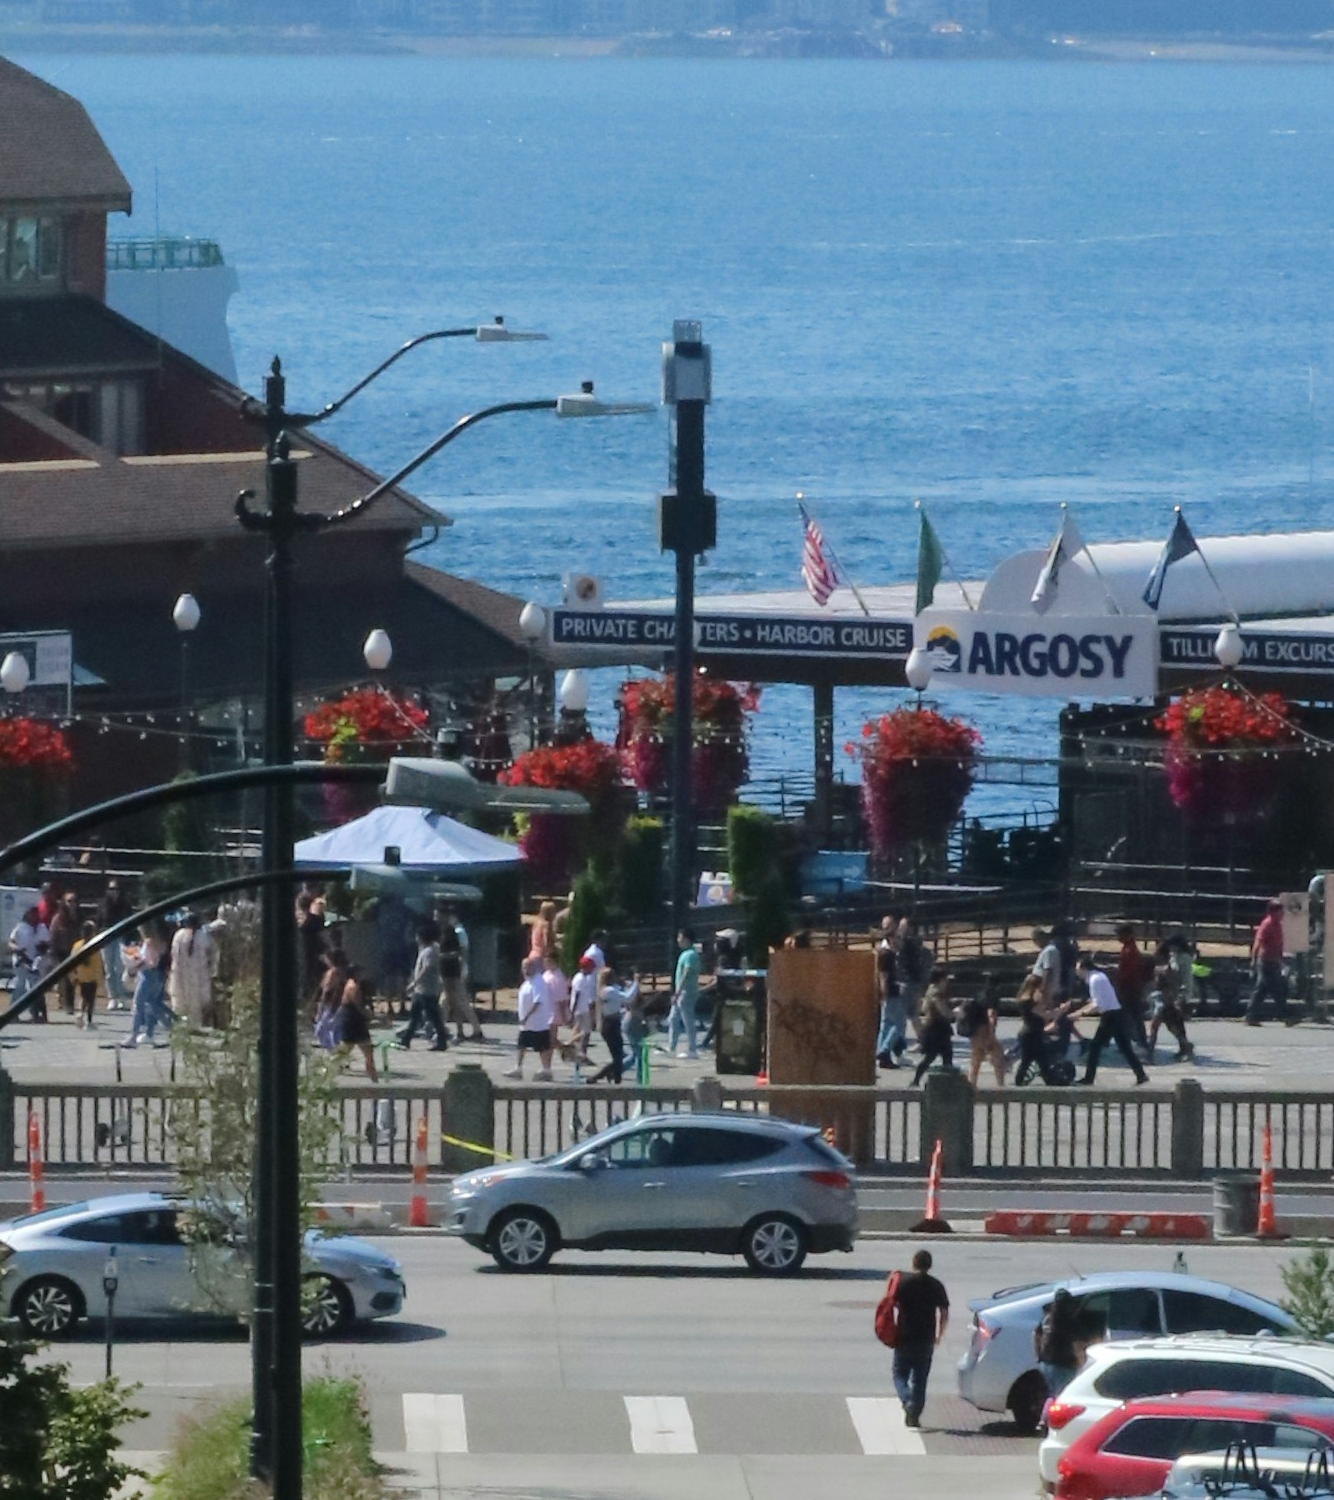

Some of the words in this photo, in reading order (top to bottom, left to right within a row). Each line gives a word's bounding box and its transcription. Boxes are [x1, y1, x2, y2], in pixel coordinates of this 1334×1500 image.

[561, 616, 638, 640] PRIVATE
[756, 624, 836, 647] HARBOR
[840, 627, 907, 648] CRUISE
[1167, 637, 1259, 659] TILLIM
[968, 631, 1134, 679] ARGOSY
